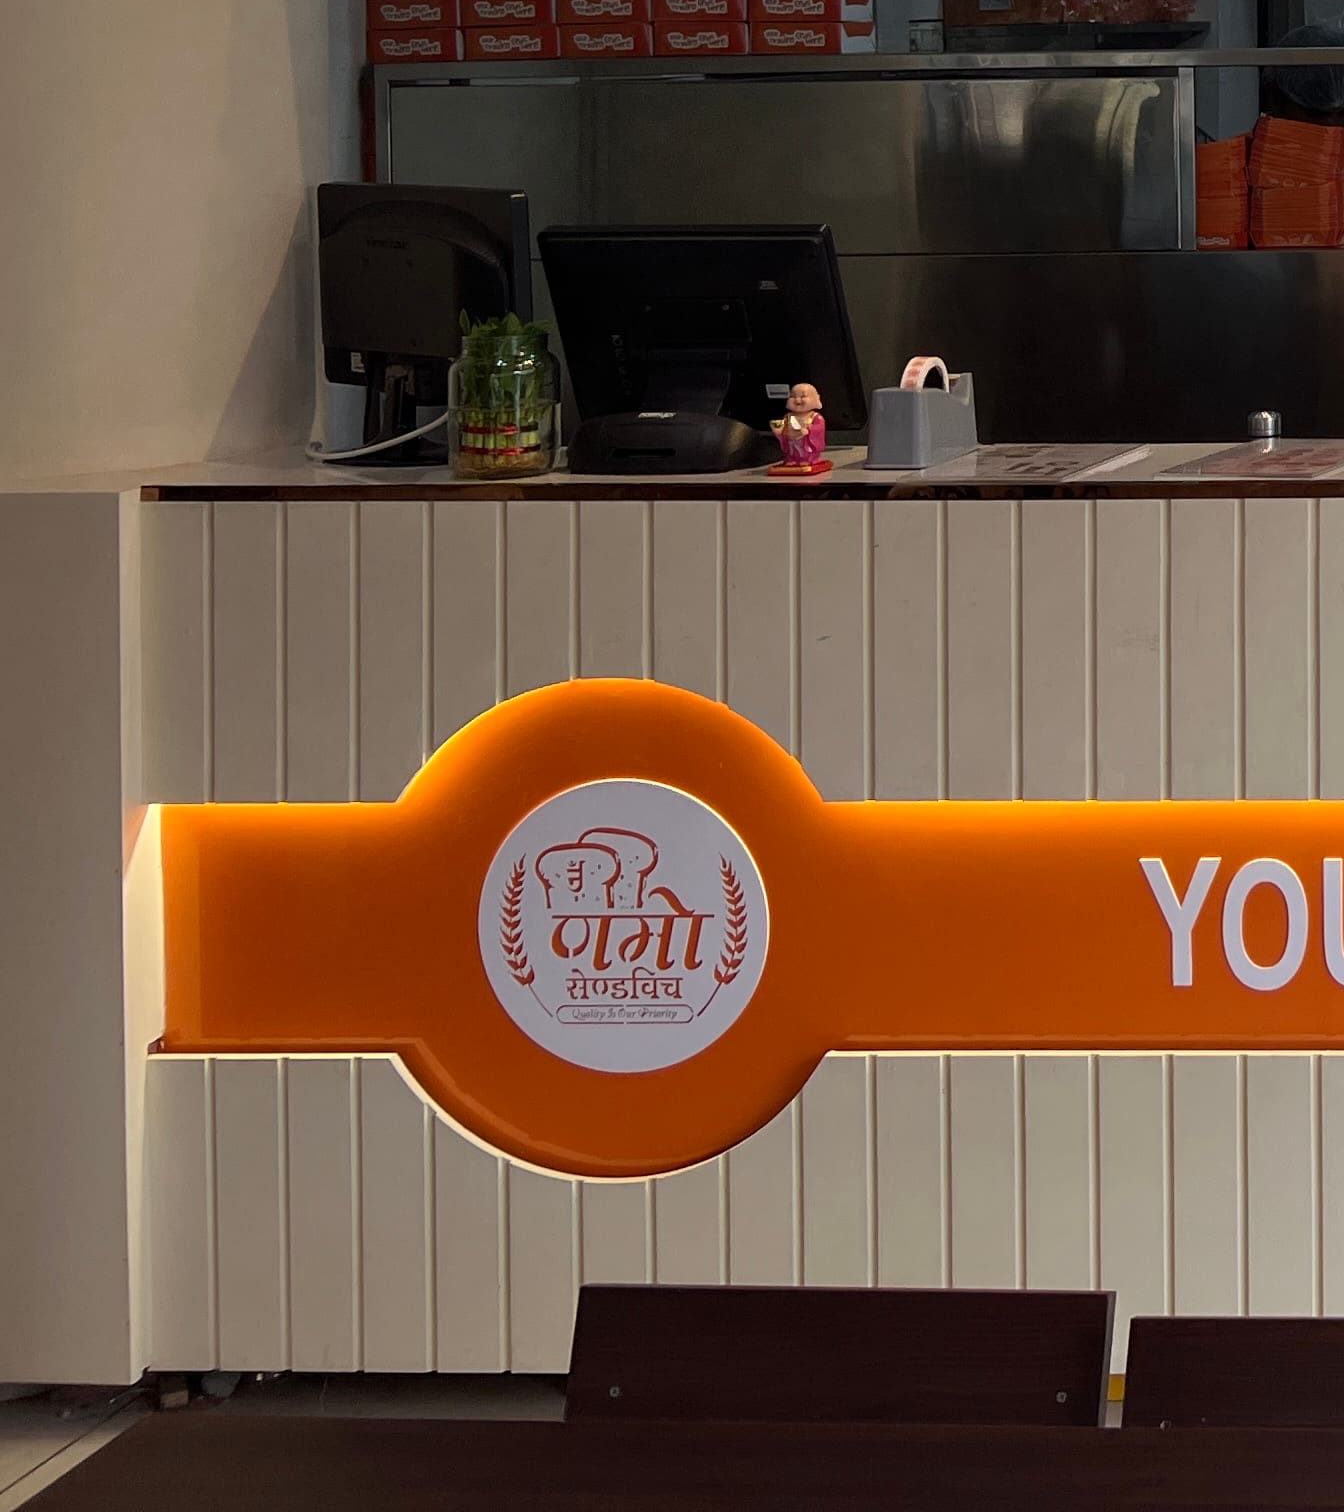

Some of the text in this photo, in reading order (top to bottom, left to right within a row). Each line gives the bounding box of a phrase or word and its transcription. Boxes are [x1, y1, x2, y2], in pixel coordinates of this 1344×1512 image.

[551, 886, 715, 971] णमो
[571, 1008, 606, 1020] Quality
[637, 1007, 678, 1020] Priority
